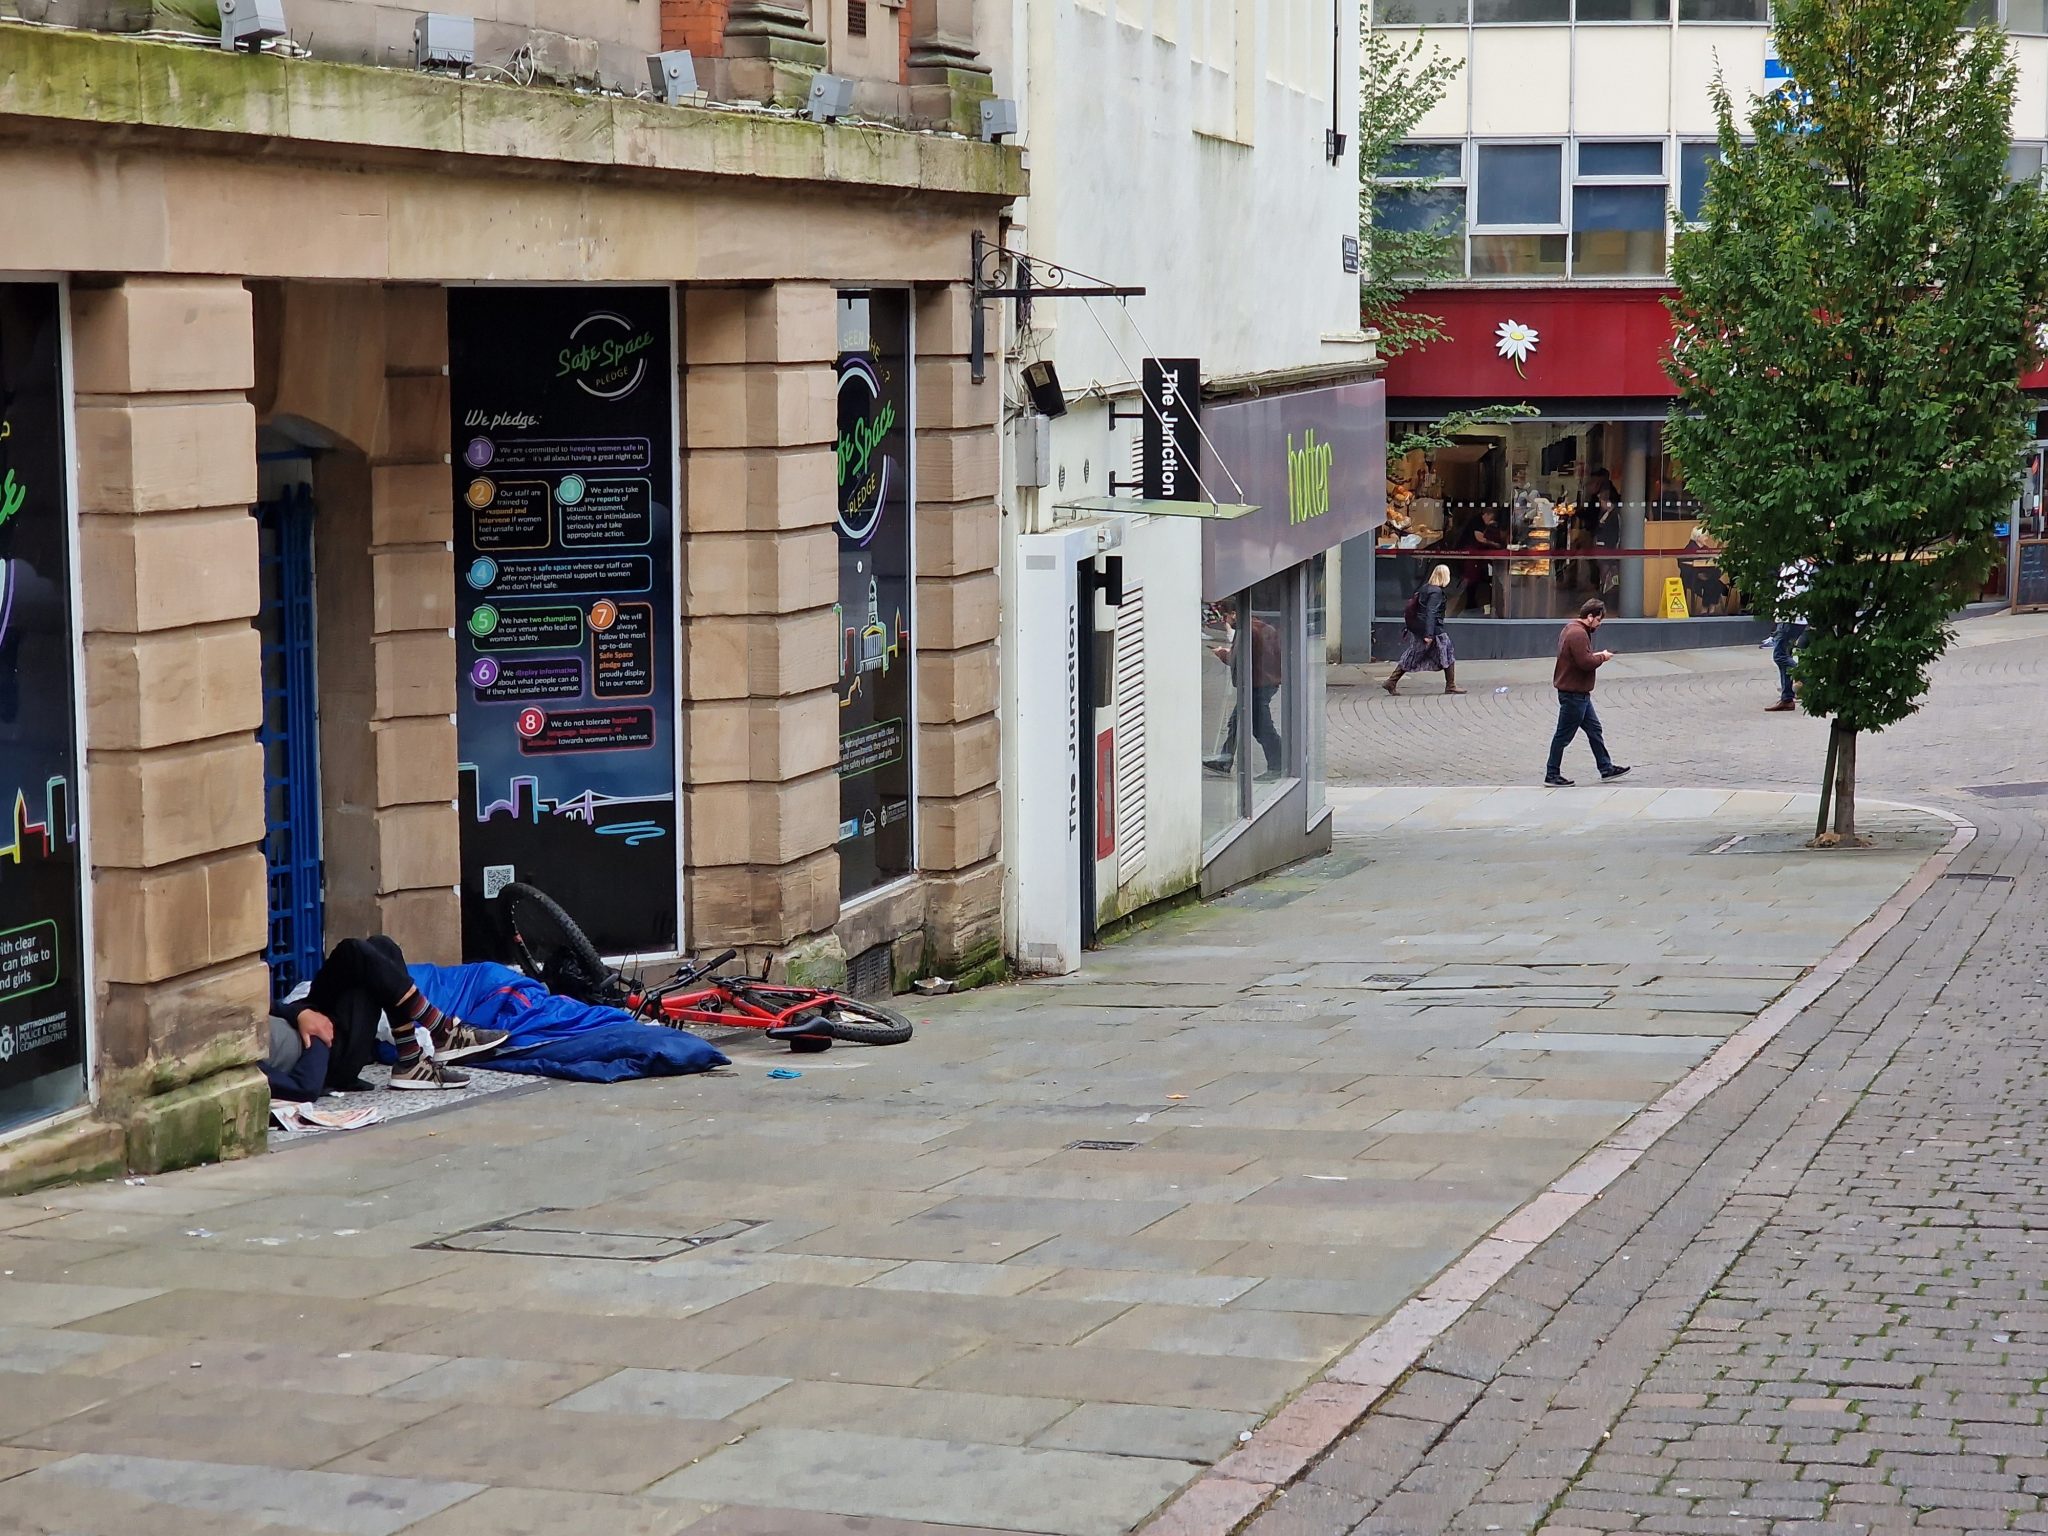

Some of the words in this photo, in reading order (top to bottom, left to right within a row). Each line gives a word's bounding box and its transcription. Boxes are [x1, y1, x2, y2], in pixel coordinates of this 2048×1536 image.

[556, 344, 600, 377] Safe
[600, 331, 654, 366] Space
[596, 366, 628, 388] PLEDGE
[1162, 369, 1178, 406] The
[464, 409, 490, 426] We
[852, 400, 895, 476] Space
[474, 445, 483, 460] 1
[525, 446, 560, 454] committed
[571, 454, 592, 462] having
[598, 454, 614, 462] great
[615, 453, 630, 461] night
[1162, 411, 1178, 496] Junction
[1288, 428, 1332, 525] hotter
[476, 486, 485, 500] 2
[602, 486, 624, 494] always
[849, 472, 876, 518] PLEDGE
[566, 531, 603, 539] appropriate
[478, 565, 487, 580] 4
[538, 564, 552, 572] safe
[553, 564, 572, 572] space
[518, 572, 572, 582] non-judgemental
[574, 572, 598, 580] support
[480, 613, 488, 629] 5
[542, 614, 577, 623] champions
[598, 608, 608, 624] 7
[489, 634, 518, 642] women's
[518, 634, 540, 642] safety.
[599, 642, 632, 650] up-to-date
[614, 652, 634, 660] Space
[478, 664, 490, 680] 6
[600, 670, 624, 678] proudly
[497, 678, 516, 686] about
[518, 677, 534, 685] what
[535, 676, 556, 685] people
[492, 687, 506, 696] they
[526, 714, 536, 730] 8
[1069, 774, 1077, 842] The
[0, 940, 12, 956] ith
[15, 936, 36, 951] clear
[2, 958, 18, 972] can
[20, 951, 39, 967] take
[40, 949, 50, 960] to
[12, 970, 32, 988] girls
[20, 1027, 40, 1042] POLICE
[48, 1020, 66, 1033] CRIME
